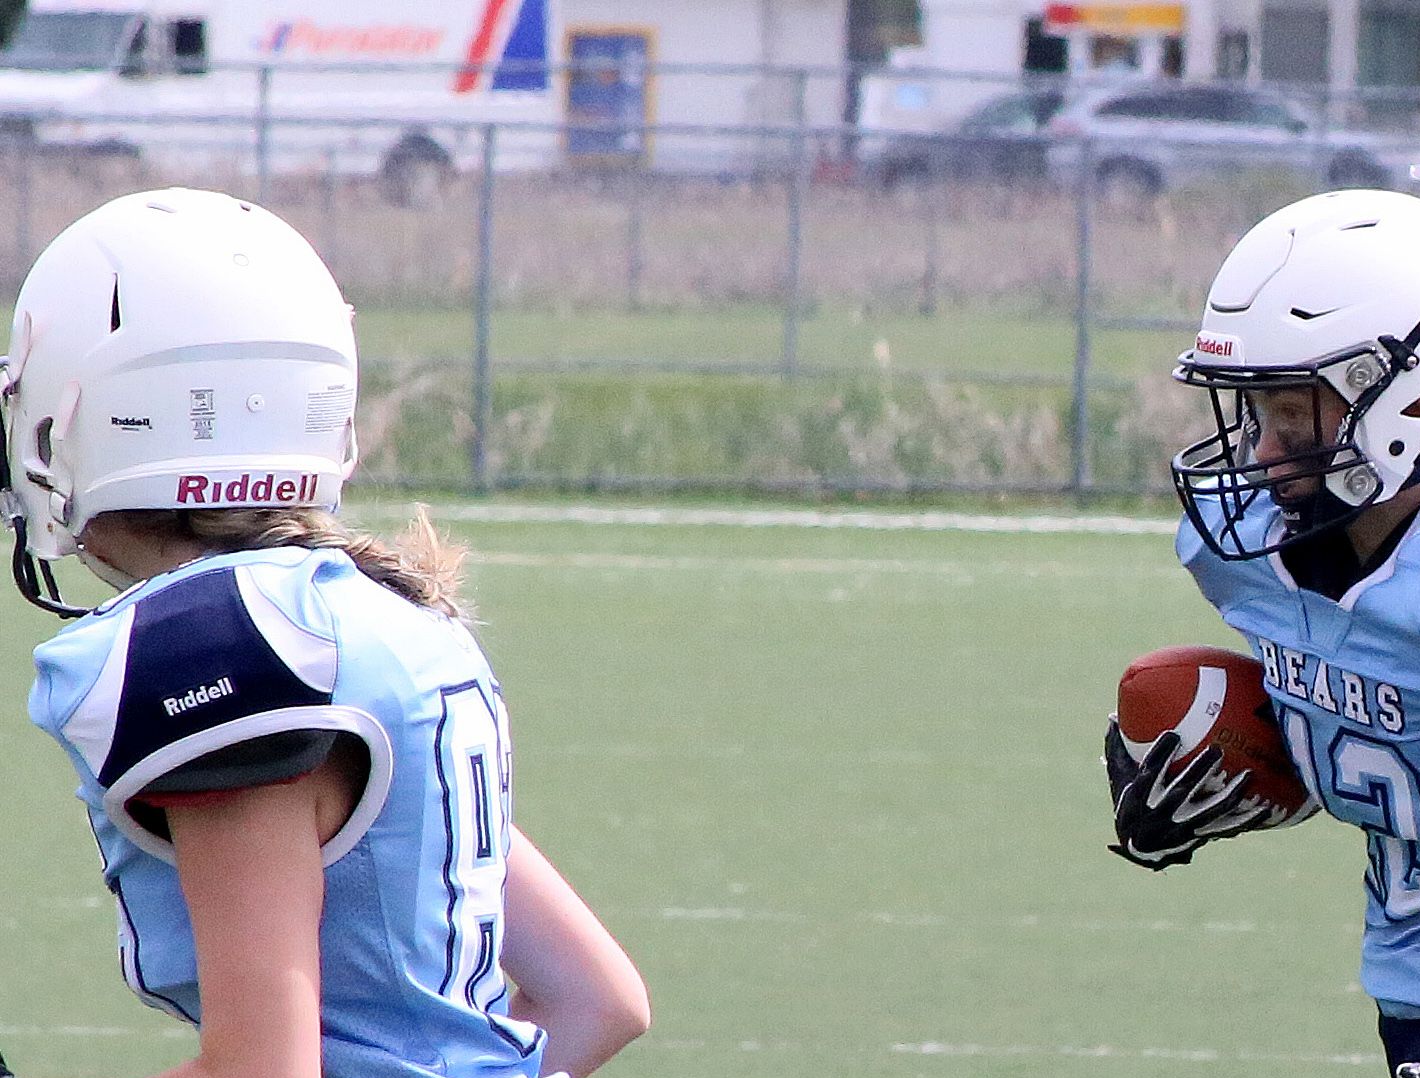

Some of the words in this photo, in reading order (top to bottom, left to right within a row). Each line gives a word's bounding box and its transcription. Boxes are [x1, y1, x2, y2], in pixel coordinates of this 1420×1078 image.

[177, 474, 319, 503] Riddell
[163, 677, 233, 716] Riddell
[1258, 636, 1406, 736] BEARS
